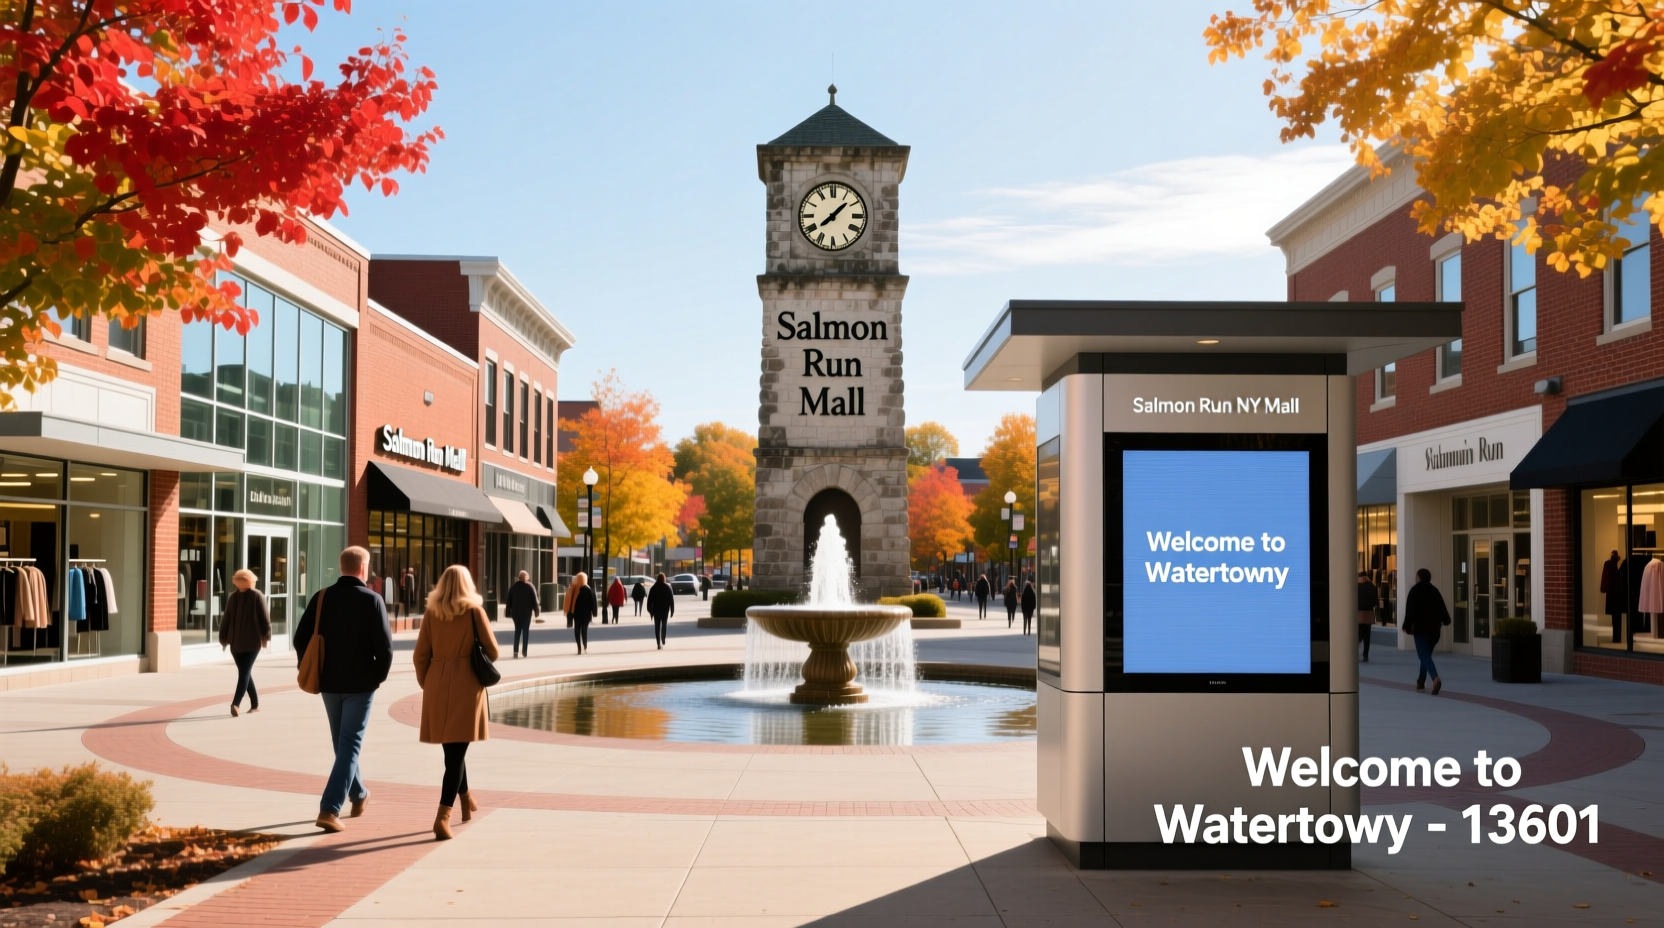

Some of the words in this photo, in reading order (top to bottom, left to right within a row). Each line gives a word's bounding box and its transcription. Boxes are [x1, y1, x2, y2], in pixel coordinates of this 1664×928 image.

[777, 310, 888, 341] Salmon
[802, 348, 863, 378] Run
[798, 386, 866, 416] Mall
[1133, 397, 1195, 414] Salmon
[1199, 397, 1232, 414] Run
[1236, 396, 1261, 414] NY
[1264, 397, 1299, 414] Mall
[1479, 437, 1504, 463] Run
[1146, 530, 1255, 552] Welcome
[1261, 532, 1286, 552] to
[1145, 561, 1289, 590] Watertowny
